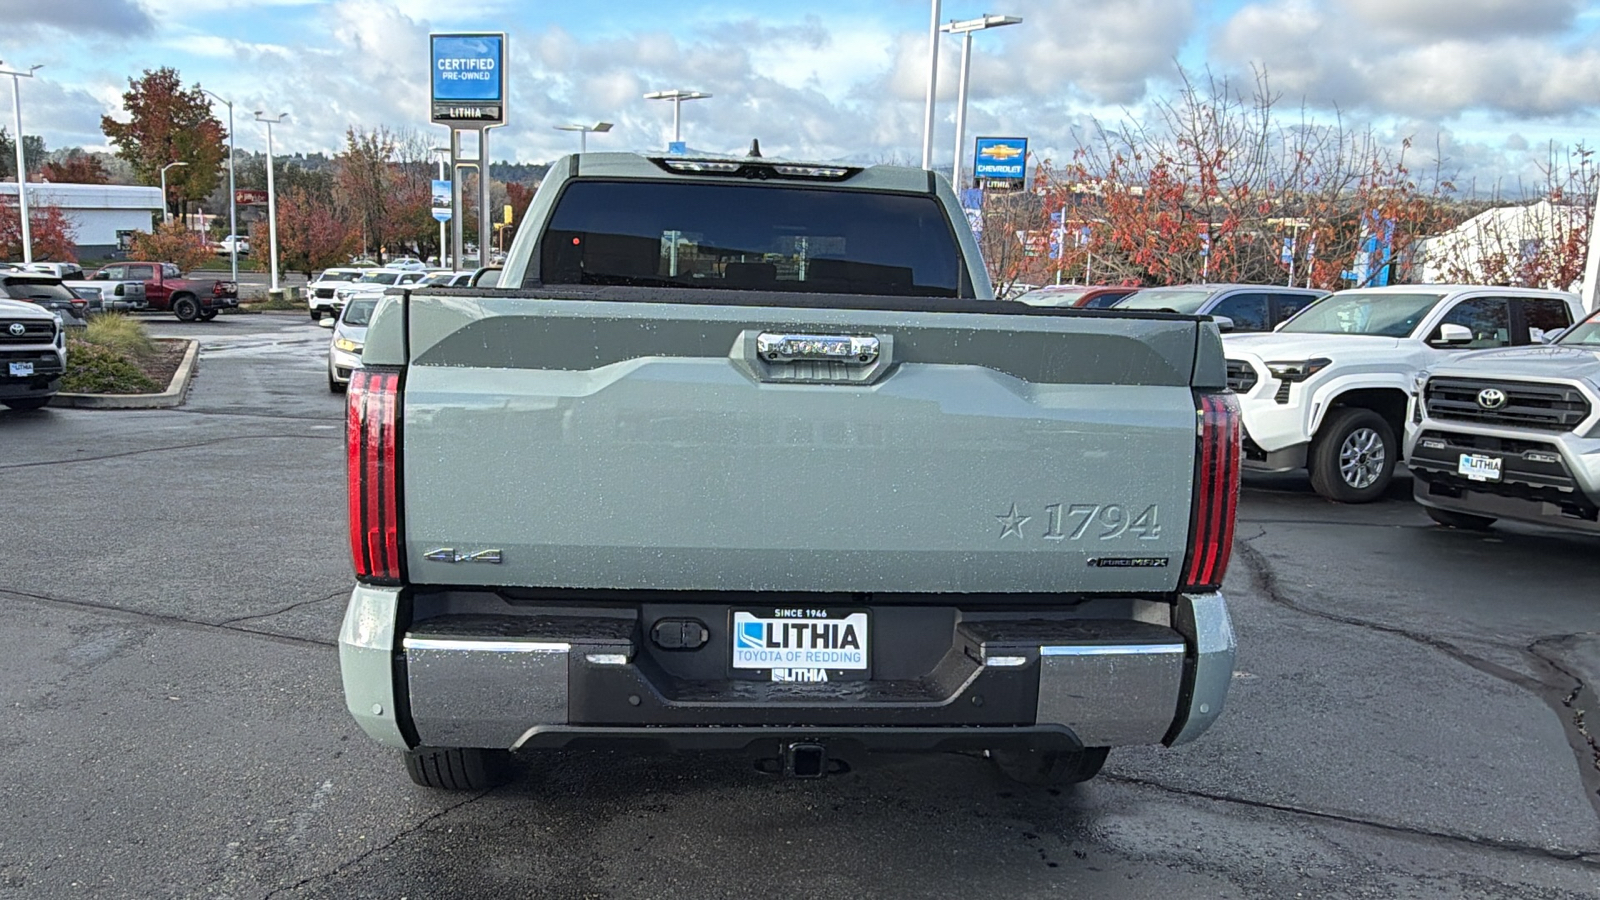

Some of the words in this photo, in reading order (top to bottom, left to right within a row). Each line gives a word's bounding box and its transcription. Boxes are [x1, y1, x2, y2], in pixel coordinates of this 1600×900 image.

[438, 58, 495, 70] CERTIFIED
[442, 71, 490, 80] PRE-OWNED
[449, 107, 482, 117] LITHIA
[978, 165, 1022, 173] CHEVROLET
[1470, 458, 1500, 470] LITHIA
[1043, 503, 1162, 541] 1794
[774, 608, 803, 618] SINCE
[805, 609, 828, 618] 1946
[766, 622, 860, 650] LITHIA
[737, 650, 783, 662] TOYOTA
[785, 651, 803, 662] OF
[805, 651, 861, 663] REDDING
[785, 668, 828, 682] LITHIA
